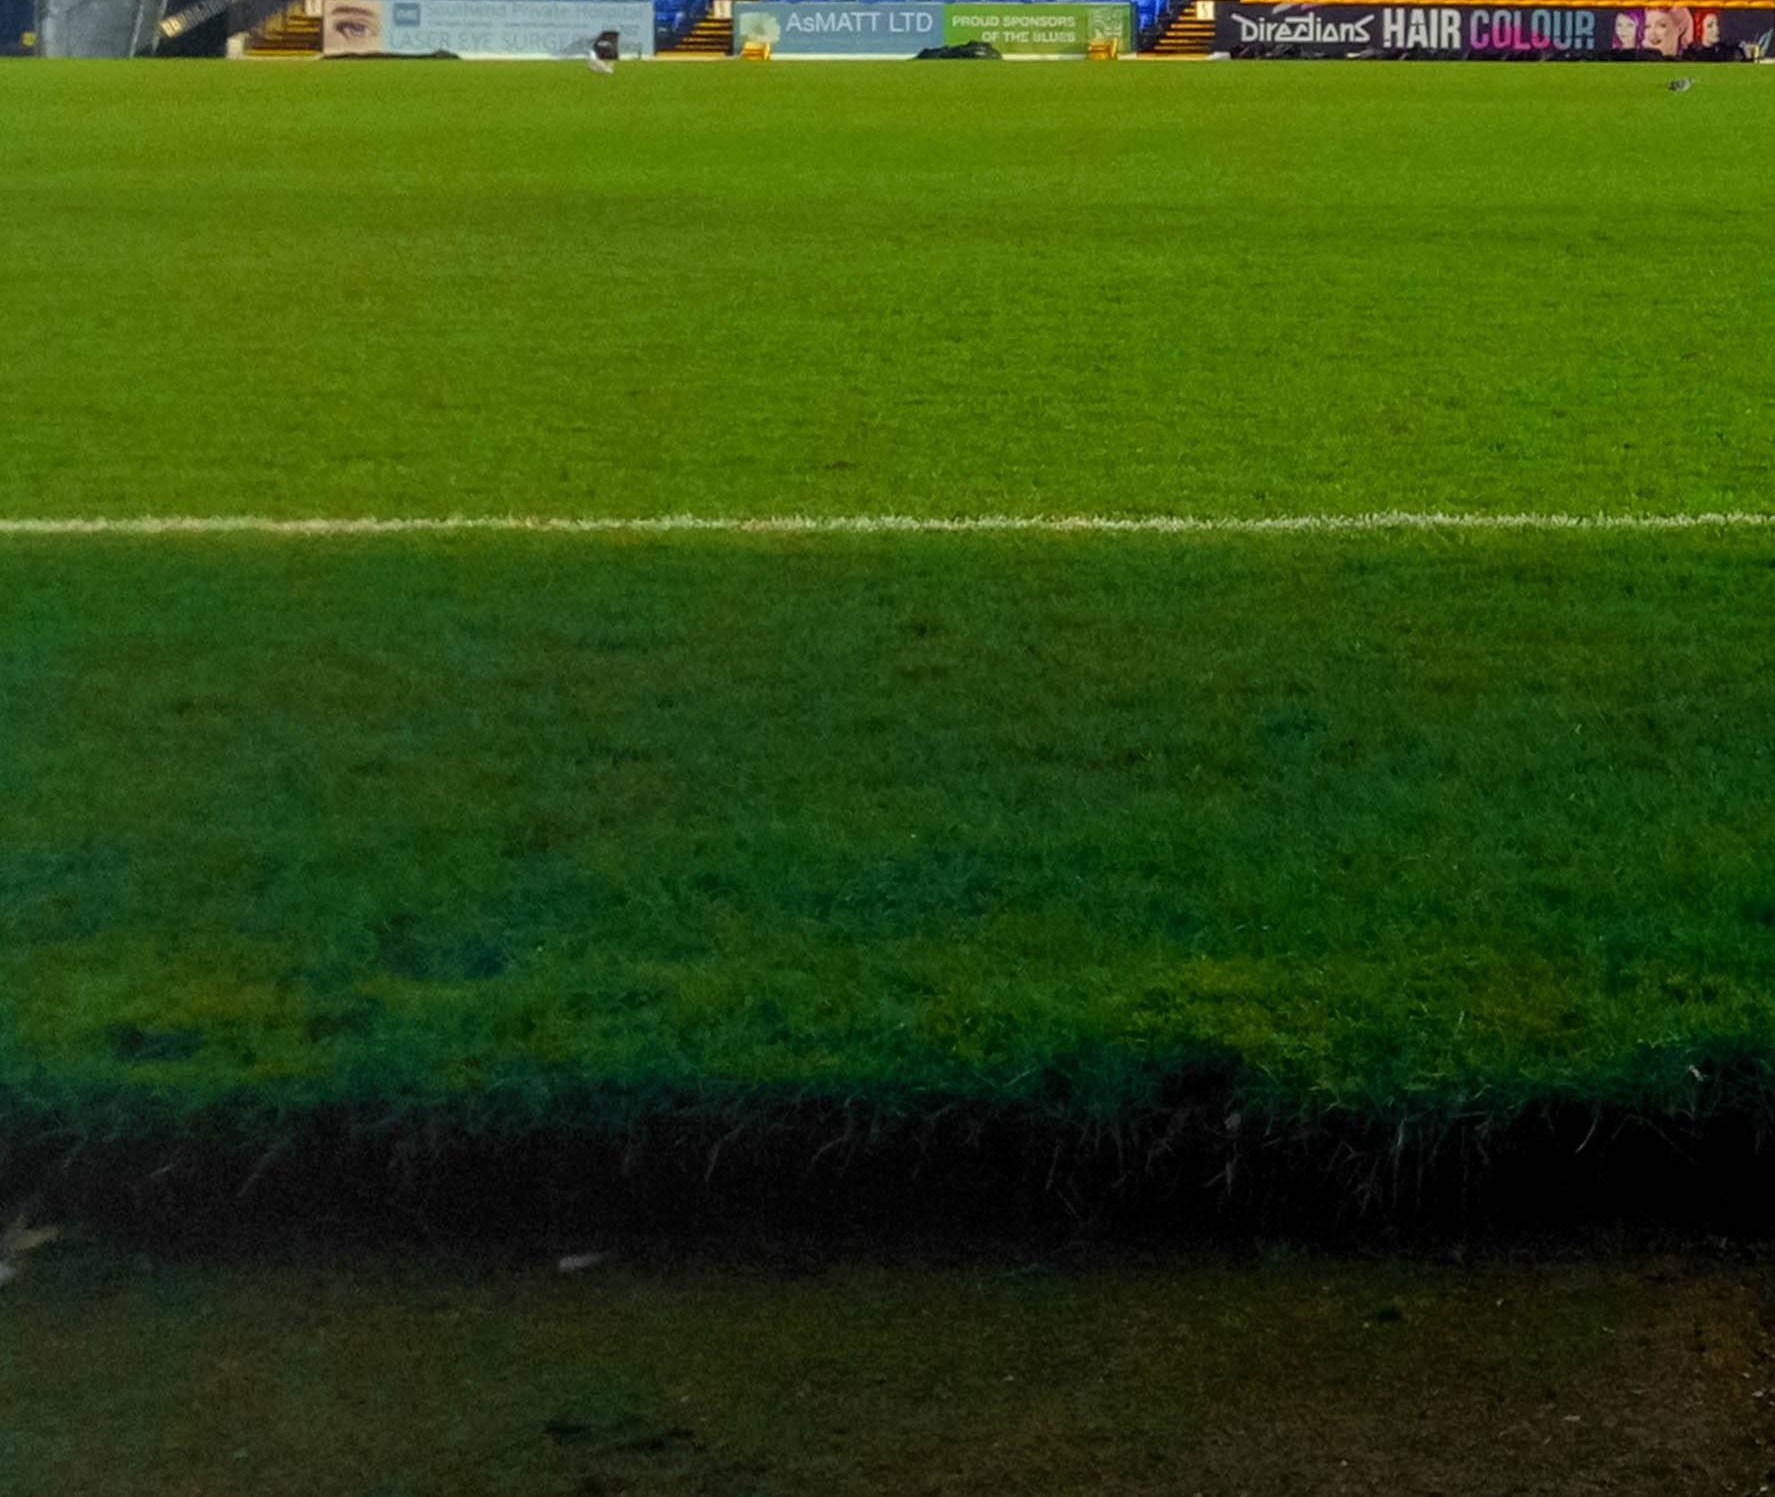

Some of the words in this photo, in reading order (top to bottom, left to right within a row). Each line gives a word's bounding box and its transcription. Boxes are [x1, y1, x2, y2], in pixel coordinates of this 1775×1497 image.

[785, 12, 881, 33] AsMATT
[889, 12, 933, 33] LTD
[952, 15, 1000, 28] PROUD
[1003, 15, 1076, 28] SPONSORS
[1383, 8, 1462, 49] HAIR
[1470, 8, 1595, 50] COLOUR
[390, 30, 450, 50] LASER
[458, 30, 491, 50] EYE
[502, 30, 600, 50] SURGE
[981, 31, 1000, 43] OF
[1003, 31, 1029, 43] THE
